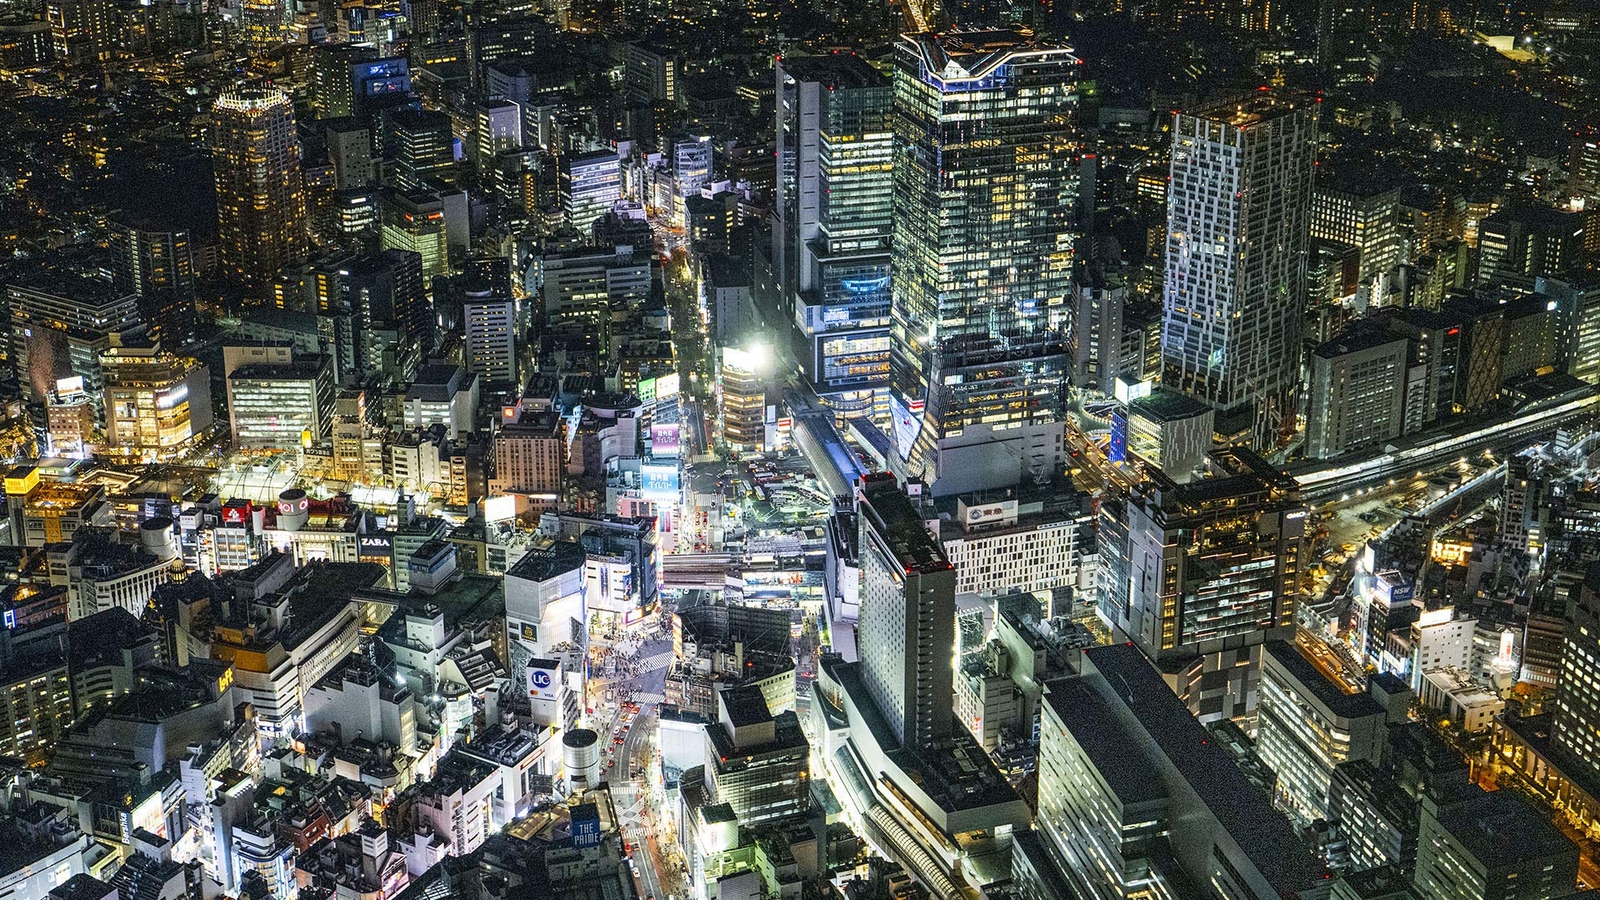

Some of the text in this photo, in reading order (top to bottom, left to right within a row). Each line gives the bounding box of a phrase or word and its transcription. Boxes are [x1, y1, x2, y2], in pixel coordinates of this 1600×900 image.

[983, 508, 1002, 516] 東急
[361, 538, 390, 547] ZARA
[1393, 586, 1411, 595] NSW
[120, 812, 130, 845] Bershka
[579, 823, 594, 835] THE
[574, 832, 599, 846] PRIME
